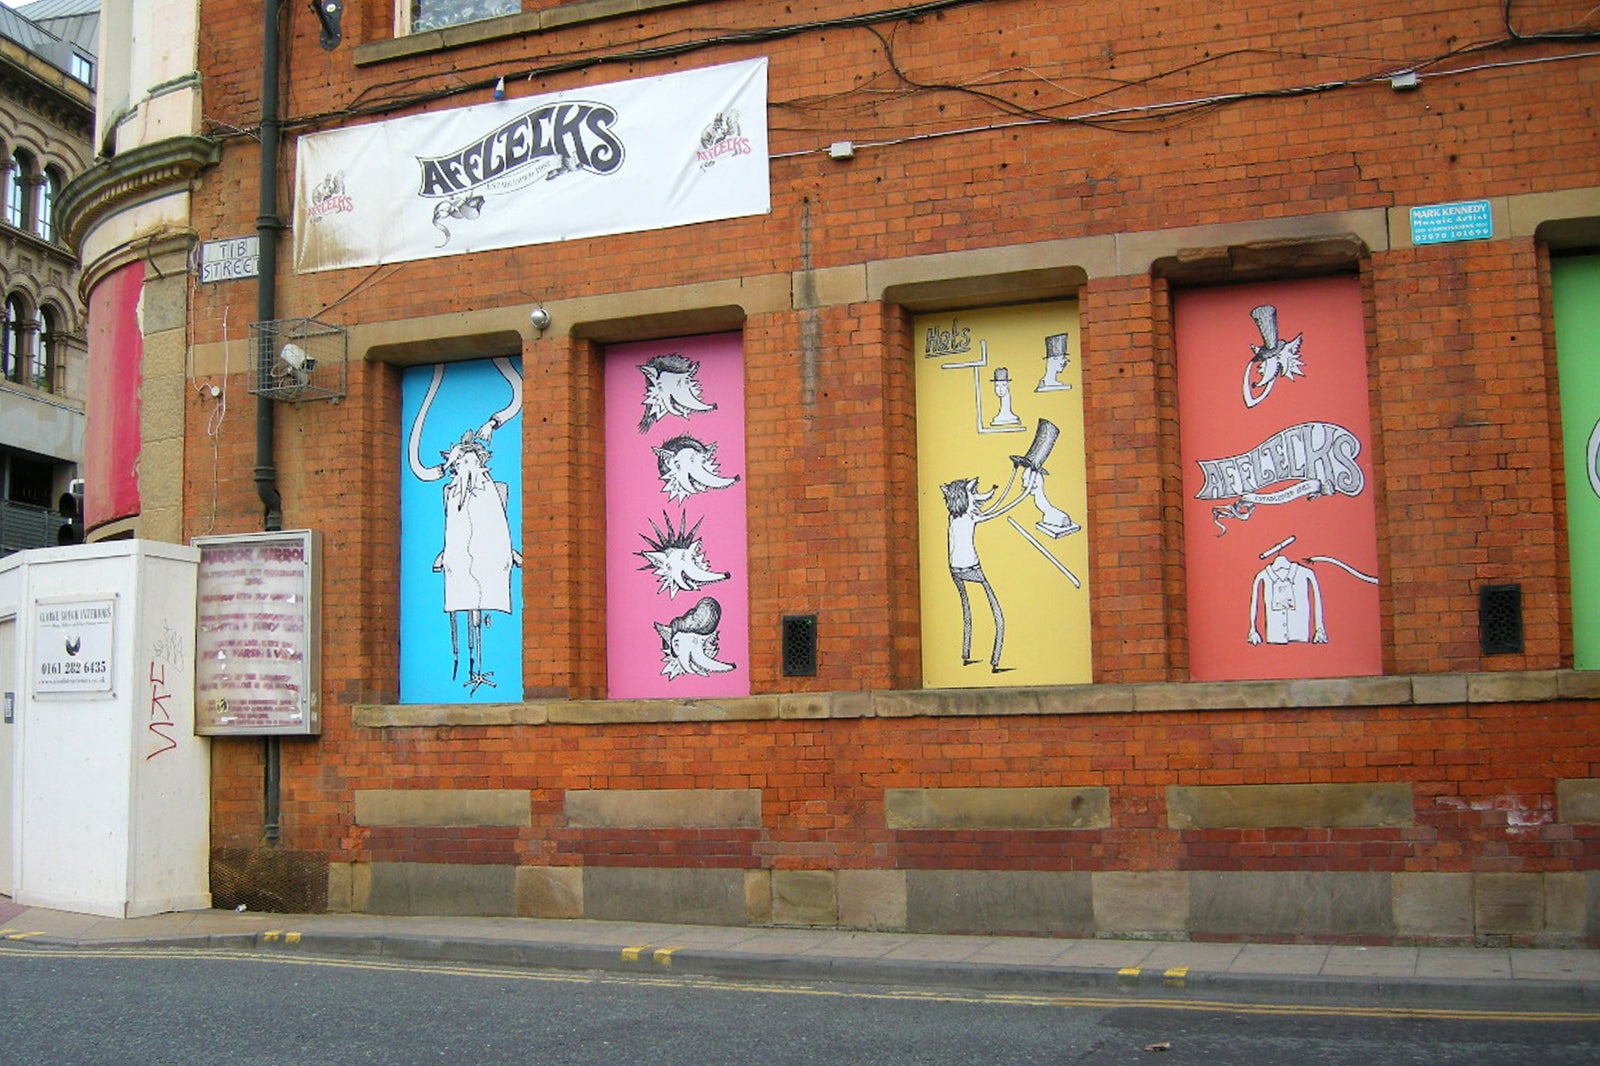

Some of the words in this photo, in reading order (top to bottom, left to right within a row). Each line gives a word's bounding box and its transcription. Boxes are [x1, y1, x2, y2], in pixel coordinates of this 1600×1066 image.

[418, 102, 624, 196] AFFLECKS
[696, 137, 752, 161] AFFLECKS
[306, 195, 353, 216] AFFLECKS
[1412, 208, 1441, 219] MARK
[1442, 203, 1487, 216] KENNEDY
[1413, 217, 1453, 227] Mosaic
[1455, 213, 1487, 222] Artist
[219, 240, 247, 259] TIB
[1199, 424, 1363, 499] AFFLECKS
[41, 662, 61, 675] 0161
[64, 661, 81, 674] 282
[83, 660, 106, 674] 6435
